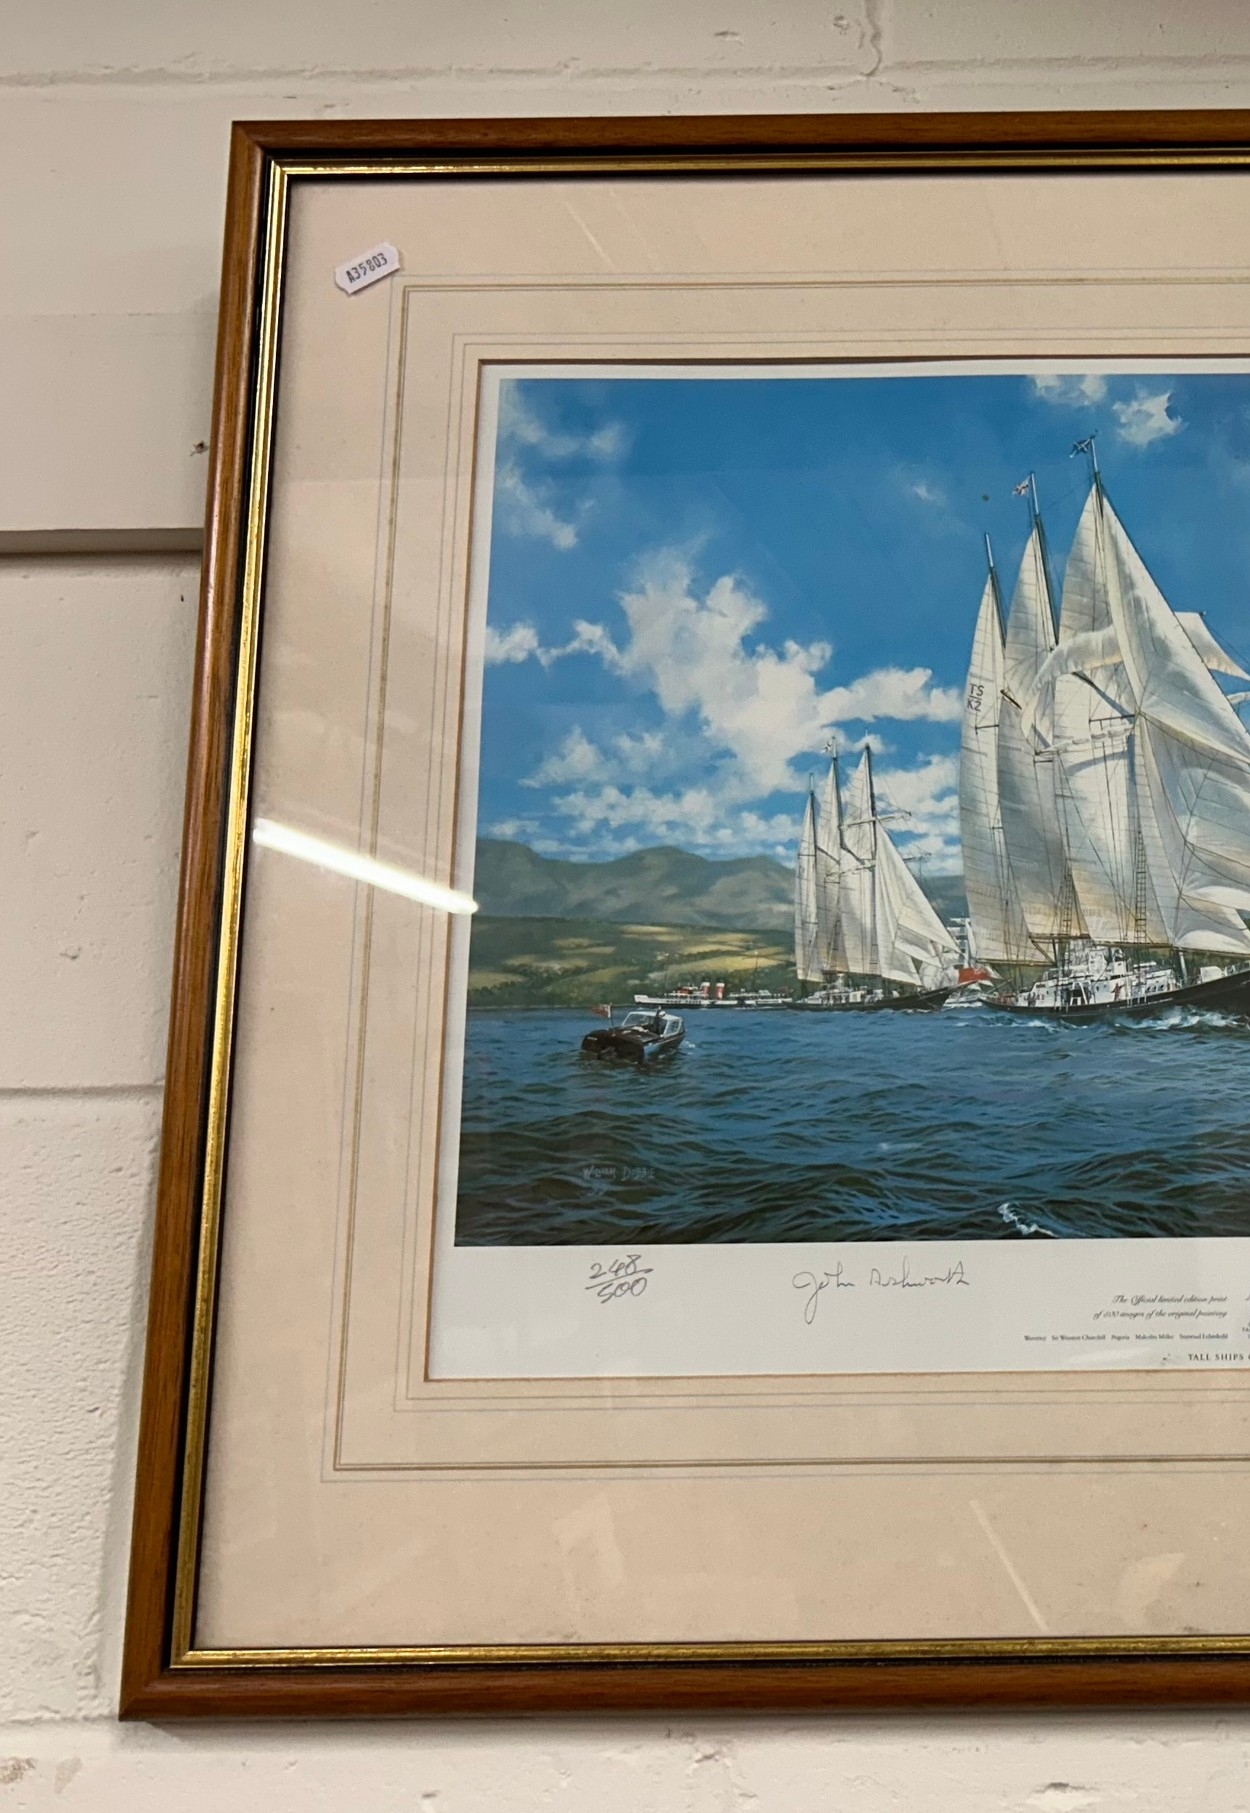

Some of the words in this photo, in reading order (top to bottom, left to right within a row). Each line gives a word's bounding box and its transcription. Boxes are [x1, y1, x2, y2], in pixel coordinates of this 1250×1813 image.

[345, 252, 388, 284] A35803
[970, 683, 985, 698] TS
[967, 698, 982, 712] K2
[588, 1254, 644, 1280] 248
[597, 1276, 649, 1304] 500
[792, 1260, 856, 1325] John
[1112, 1295, 1128, 1304] The
[1093, 1309, 1103, 1320] of
[1145, 1309, 1156, 1320] of
[1156, 1308, 1167, 1318] the
[1188, 1353, 1211, 1361] TALL
[1214, 1353, 1244, 1361] SHIPS
